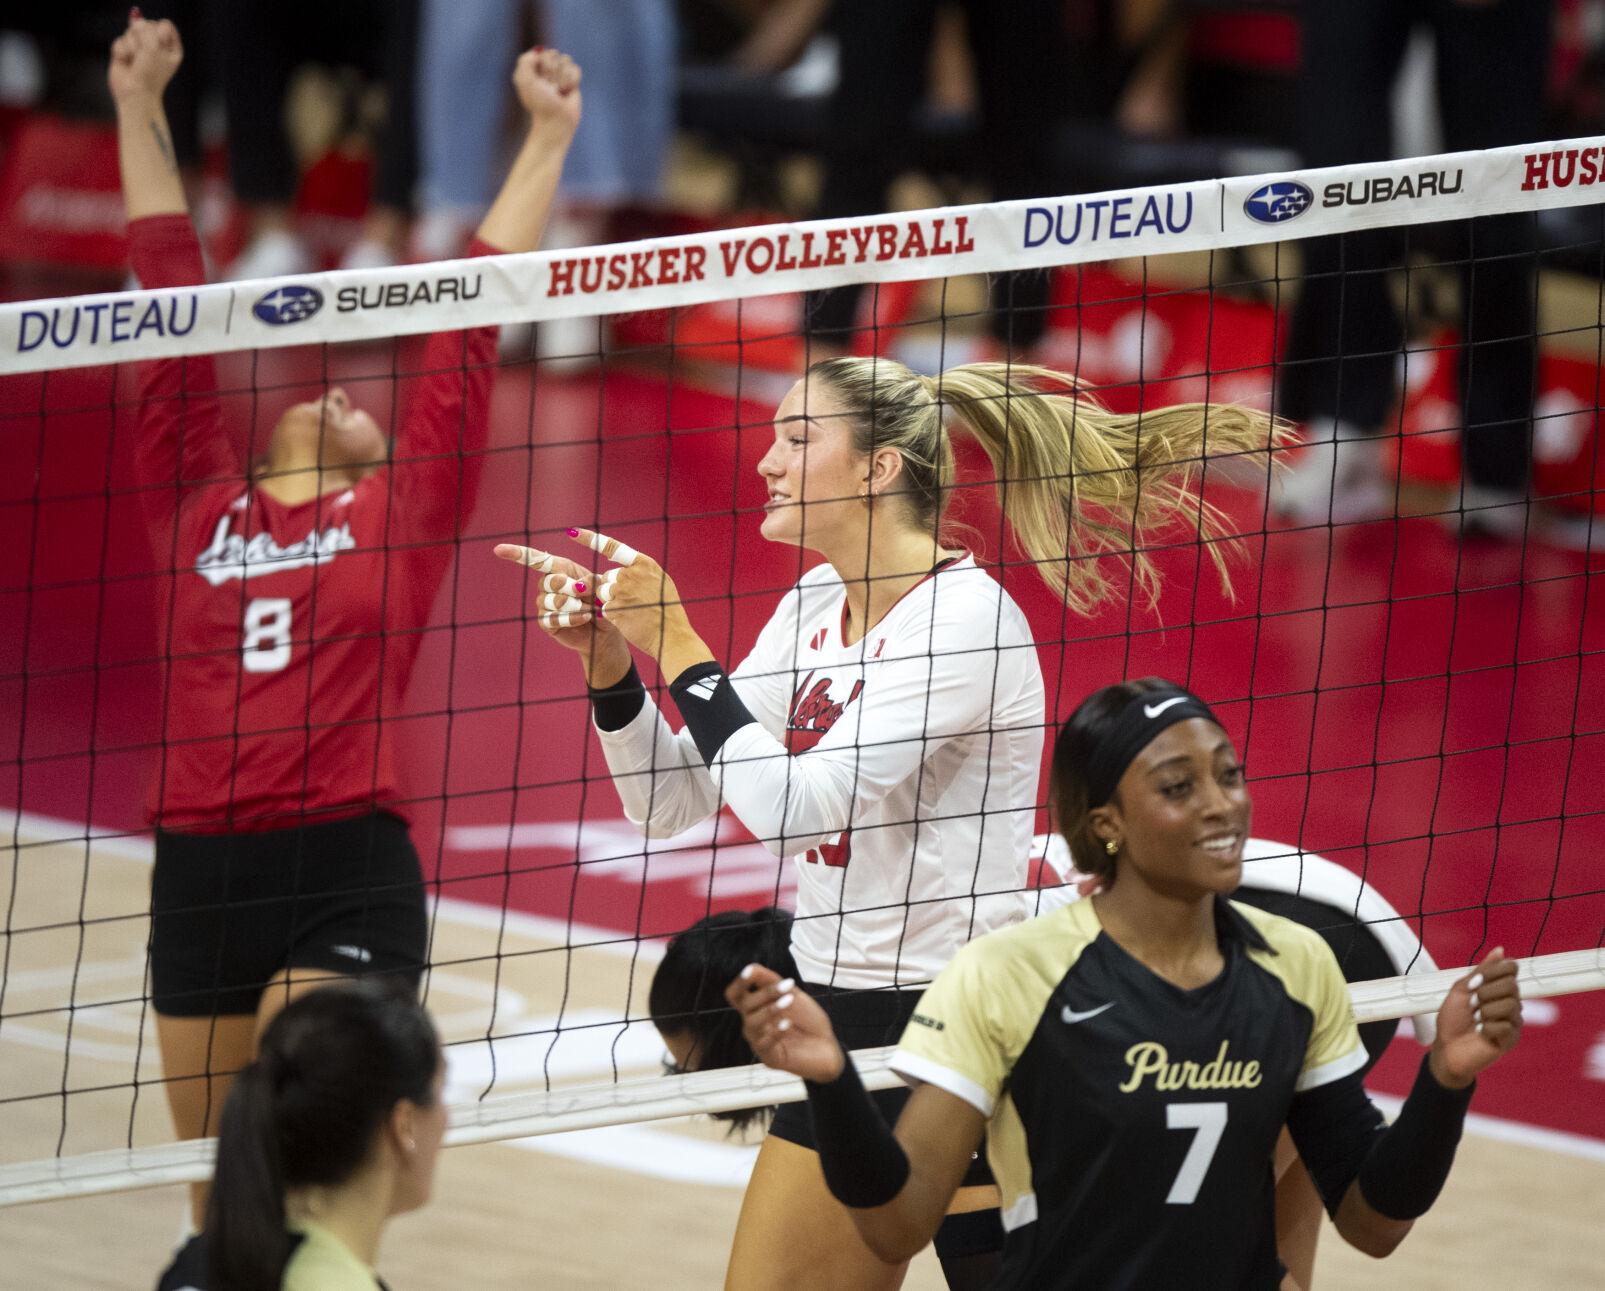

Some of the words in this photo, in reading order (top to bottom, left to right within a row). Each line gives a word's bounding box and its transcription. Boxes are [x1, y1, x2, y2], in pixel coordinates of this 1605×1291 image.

[1023, 191, 1193, 248] DUTEAU
[1322, 168, 1461, 208] SUBARU
[1520, 145, 1605, 192] HUS
[547, 245, 707, 297] HUSKER
[719, 216, 975, 277] VOLLEYBALL
[17, 294, 199, 353] DUTEAU
[336, 273, 482, 312] SUBARU
[242, 597, 293, 673] 8
[1118, 1039, 1263, 1093] Purdue
[1165, 1102, 1229, 1205] 7
